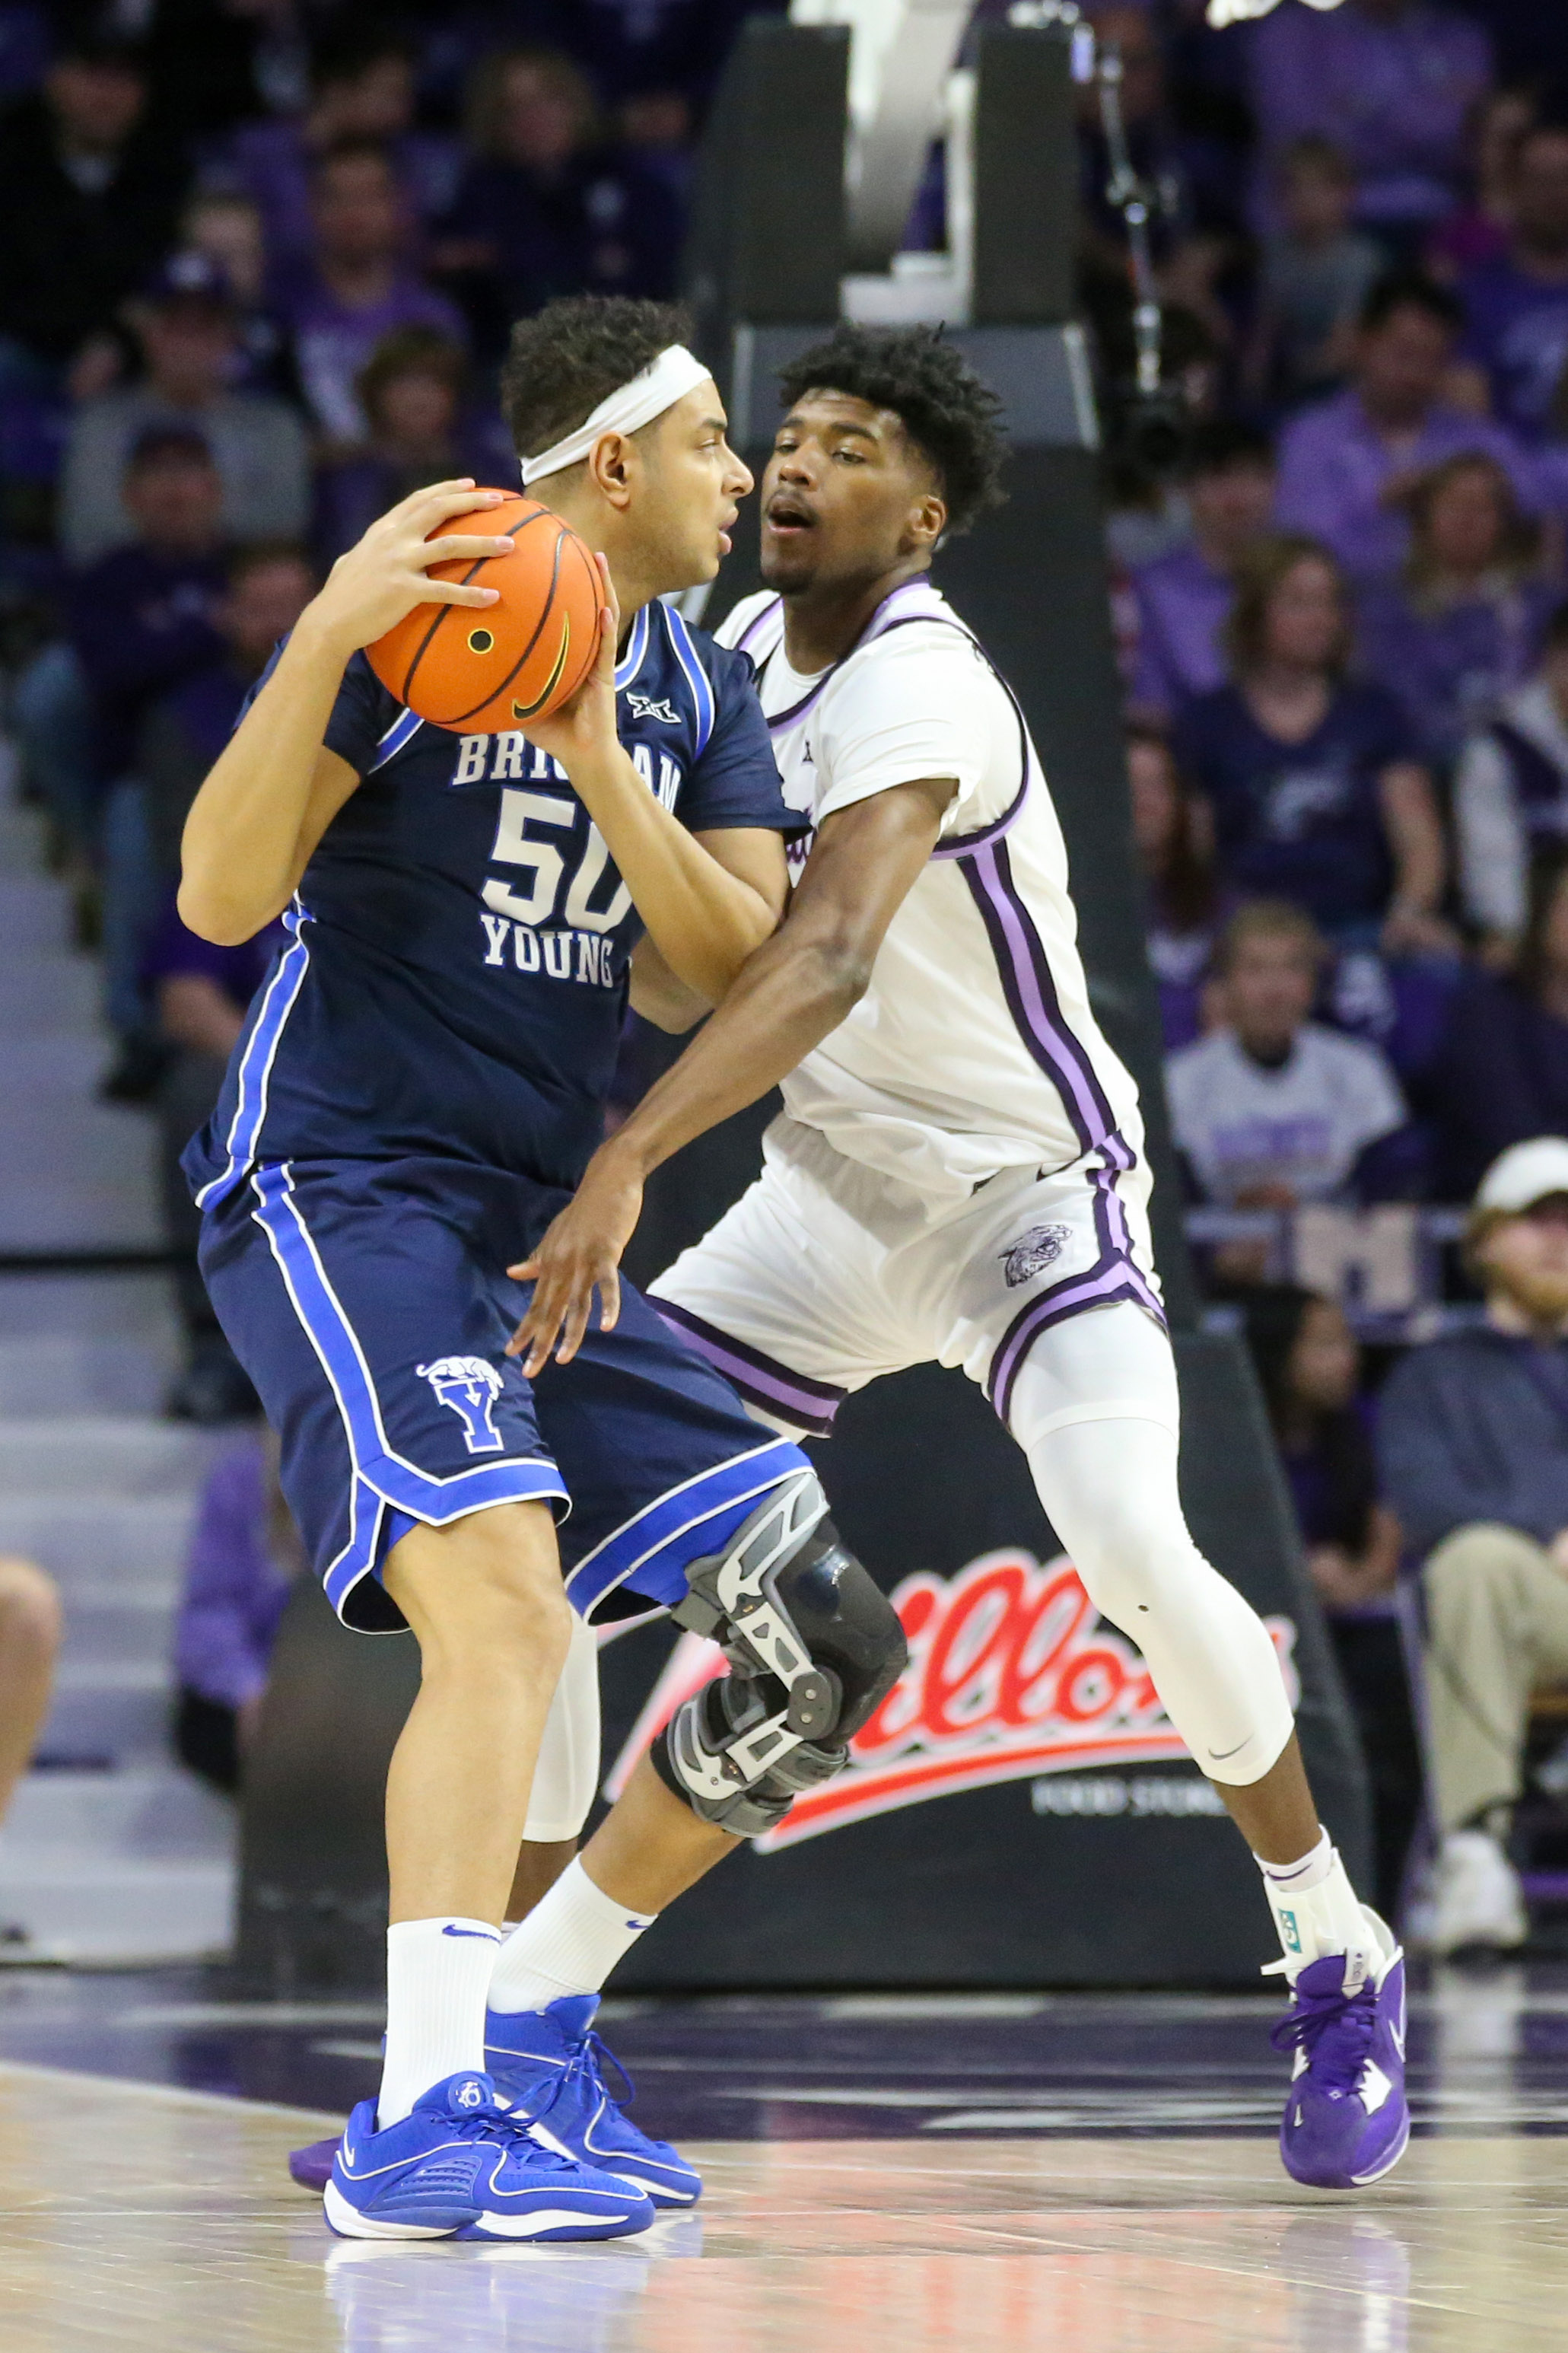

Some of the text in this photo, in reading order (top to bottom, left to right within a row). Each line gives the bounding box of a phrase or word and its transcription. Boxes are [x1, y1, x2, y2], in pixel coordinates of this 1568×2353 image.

[452, 731, 682, 815] BRIAM
[481, 787, 633, 935] 50
[479, 914, 613, 989] YOUNG
